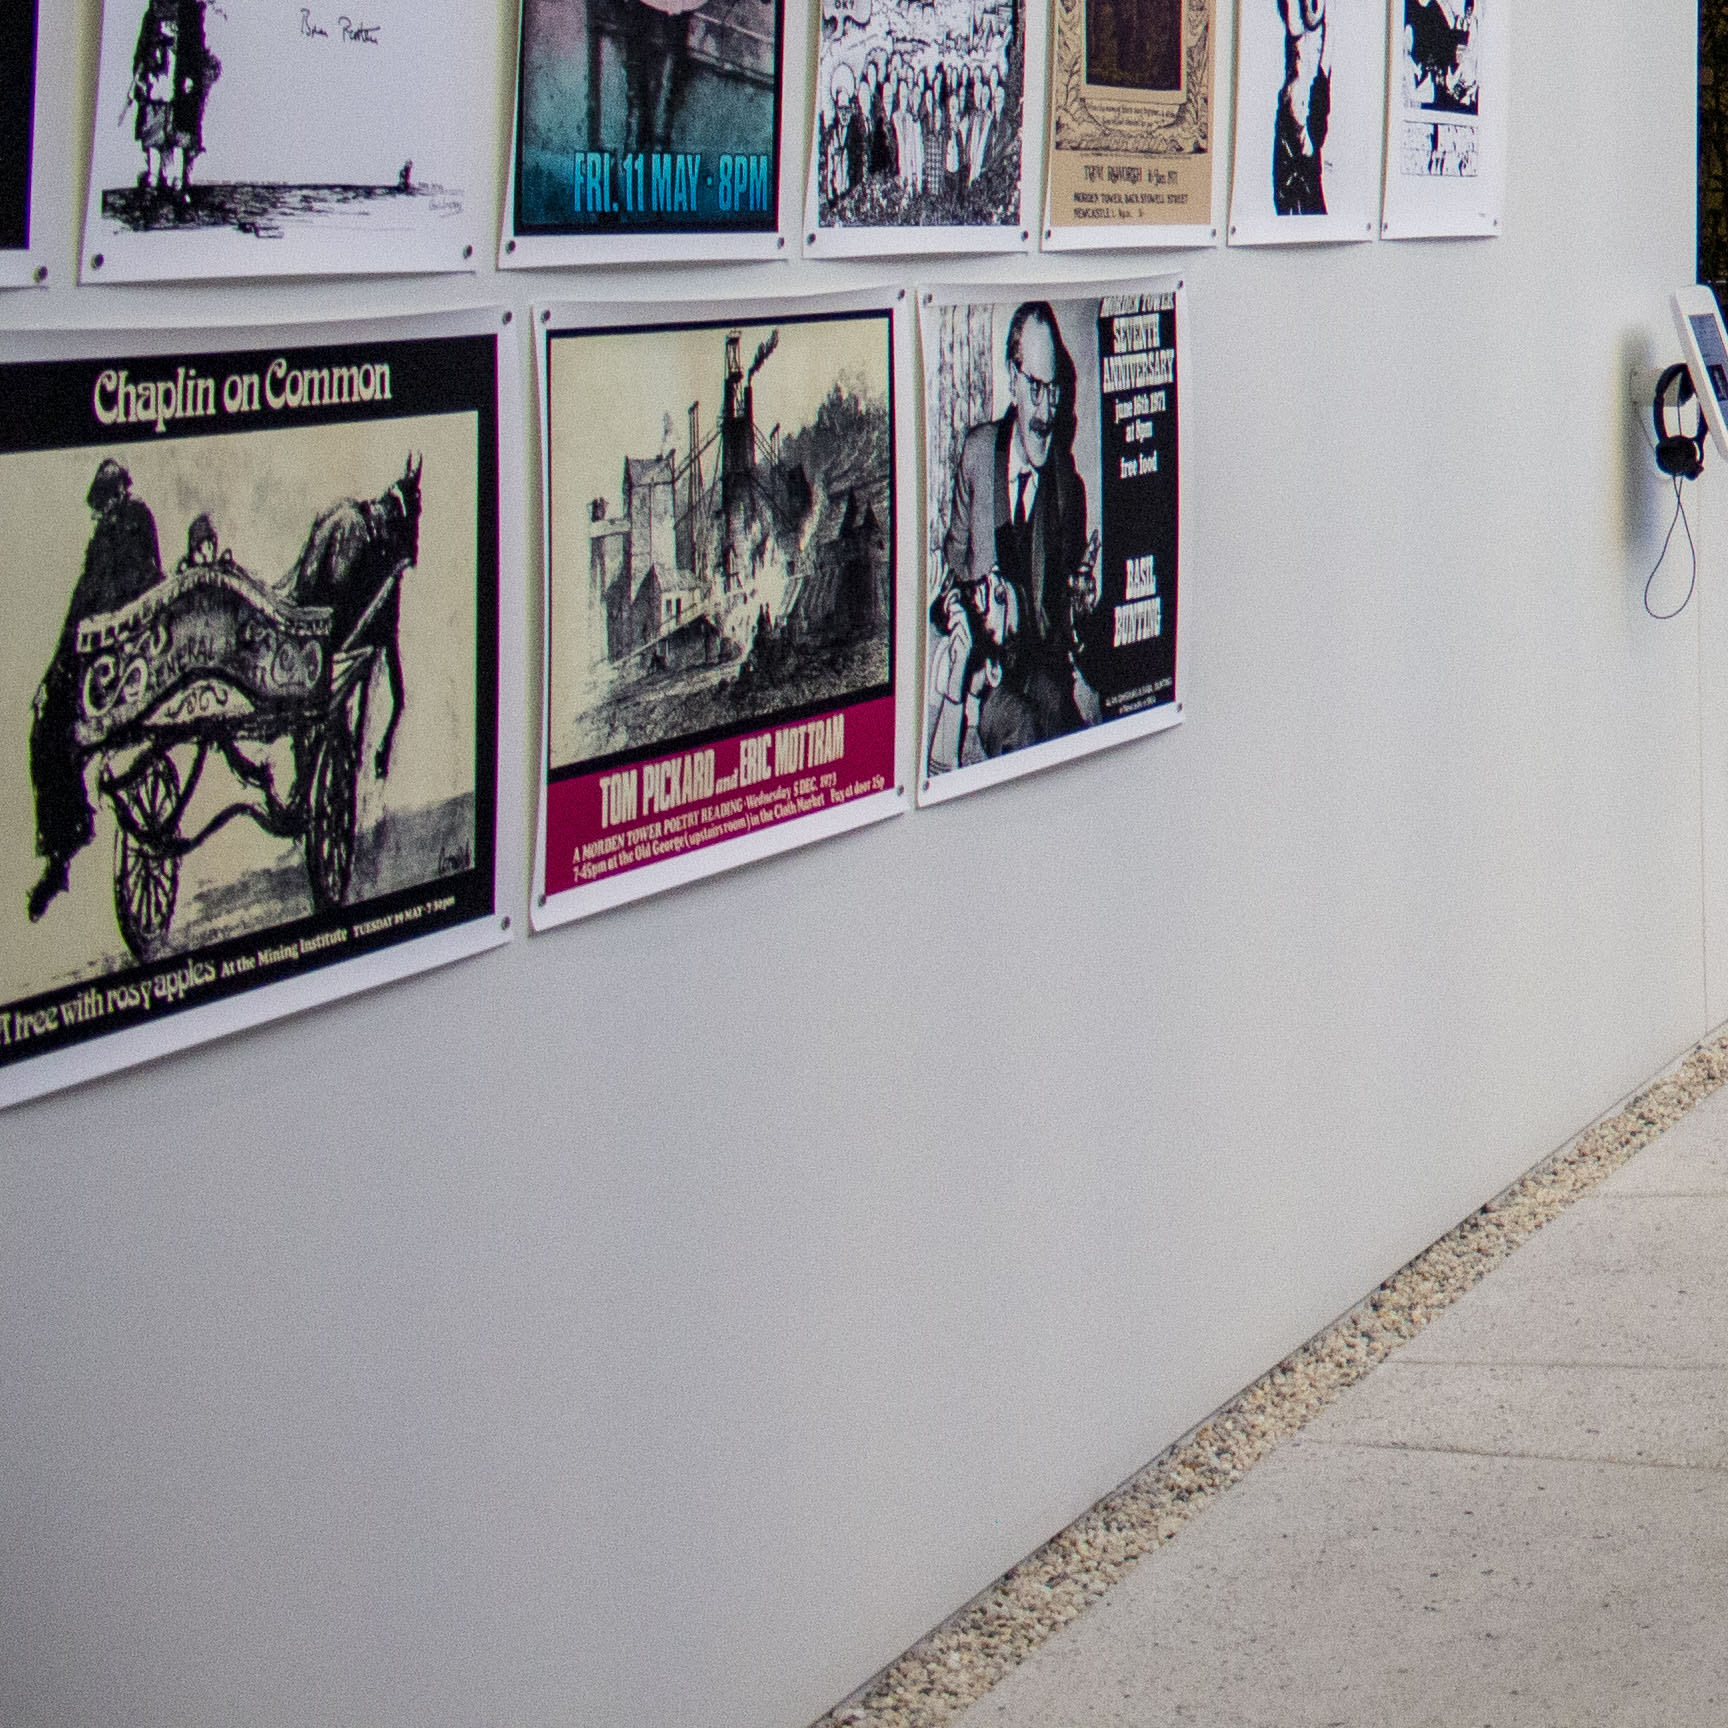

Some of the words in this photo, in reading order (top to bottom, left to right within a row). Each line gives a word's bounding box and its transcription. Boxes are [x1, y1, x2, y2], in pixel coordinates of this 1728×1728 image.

[574, 152, 619, 212] FRI.
[623, 152, 645, 212] 11
[652, 153, 701, 212] MAY
[718, 154, 768, 212] 8PM
[1113, 313, 1160, 354] SEVENTH
[93, 366, 217, 433] Chaplin
[222, 373, 262, 413] on
[265, 357, 393, 410] Common
[1103, 348, 1175, 394] ANNIVERSARY
[1115, 398, 1133, 424] june
[1126, 423, 1135, 443] at
[1120, 456, 1138, 479] free
[1139, 449, 1158, 474] food
[1125, 554, 1157, 600] BASIL
[1113, 596, 1162, 648] BUNTING
[599, 769, 637, 829] TOM
[643, 749, 715, 816] PICKARD
[715, 768, 739, 795] and
[740, 733, 772, 787] ERIC
[775, 713, 845, 777] MOTTRAM
[572, 846, 581, 865] A
[582, 833, 625, 861] MORDEN
[626, 822, 663, 847] TOWER
[663, 810, 700, 835] POETRY
[701, 797, 743, 824] READING
[746, 785, 792, 809] Wednesday
[793, 781, 799, 797] 5
[799, 776, 818, 794] DEC.
[820, 772, 837, 788] 1973
[607, 855, 619, 870] at
[618, 850, 634, 867] the
[634, 842, 651, 861] Old
[652, 835, 685, 856] George
[750, 813, 759, 826] in
[760, 808, 773, 823] the
[774, 800, 797, 818] Cloth
[797, 793, 825, 813] Market
[830, 788, 845, 803] Pay
[845, 784, 853, 798] at
[854, 780, 871, 796] door
[14, 1005, 59, 1042] tree
[59, 987, 104, 1026] with
[105, 980, 152, 1010] rosy
[153, 958, 216, 1004] apples
[220, 962, 236, 978] At
[237, 956, 255, 972] the
[257, 943, 299, 966] Mining
[299, 929, 348, 955] Institute
[352, 914, 393, 938] TUESDAY
[403, 906, 423, 923] MAY
